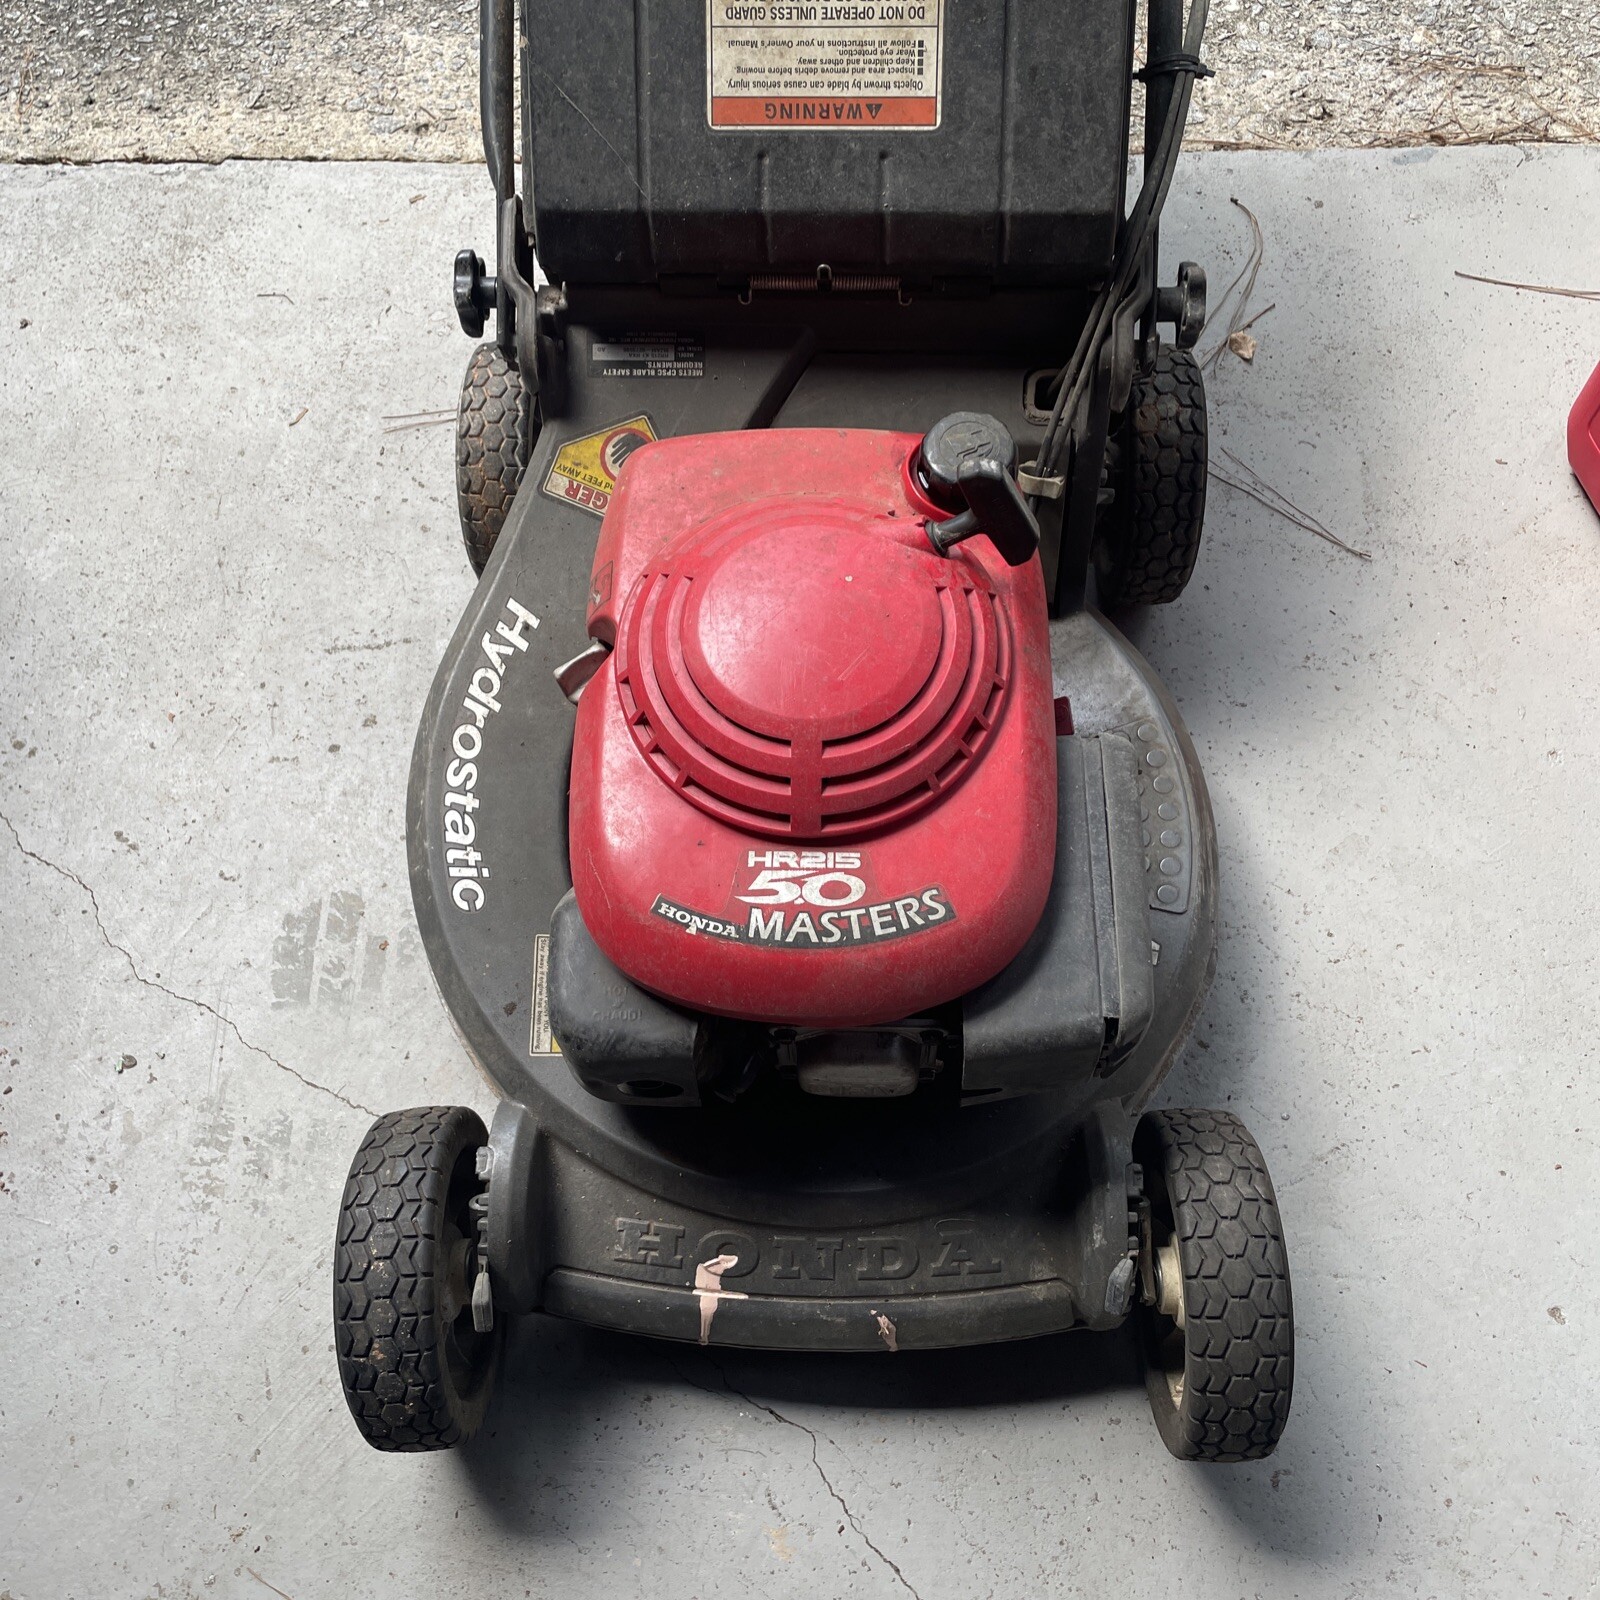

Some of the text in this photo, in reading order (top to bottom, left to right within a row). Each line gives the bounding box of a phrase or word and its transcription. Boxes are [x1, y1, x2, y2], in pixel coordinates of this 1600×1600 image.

[726, 6, 925, 20] DO NOT OPERATE UNLESS GUARD
[726, 39, 916, 48] Follow all instructions in your Owner's Manual.
[837, 48, 915, 56] Wear eye protection.
[797, 57, 915, 66] Keep children and others away.
[734, 66, 915, 75] Inspect area and remove debris before mowing.
[726, 79, 922, 90] Objects thrown by blade can cause serious injury.
[765, 103, 862, 119] WARNING
[556, 464, 581, 478] AWAY
[582, 473, 604, 487] FEET
[565, 480, 608, 510] GER
[444, 596, 541, 912] Hydrostatic
[748, 850, 861, 869] HR215
[658, 888, 946, 943] HONDA MASTERS
[614, 1217, 1000, 1281] HONDA
